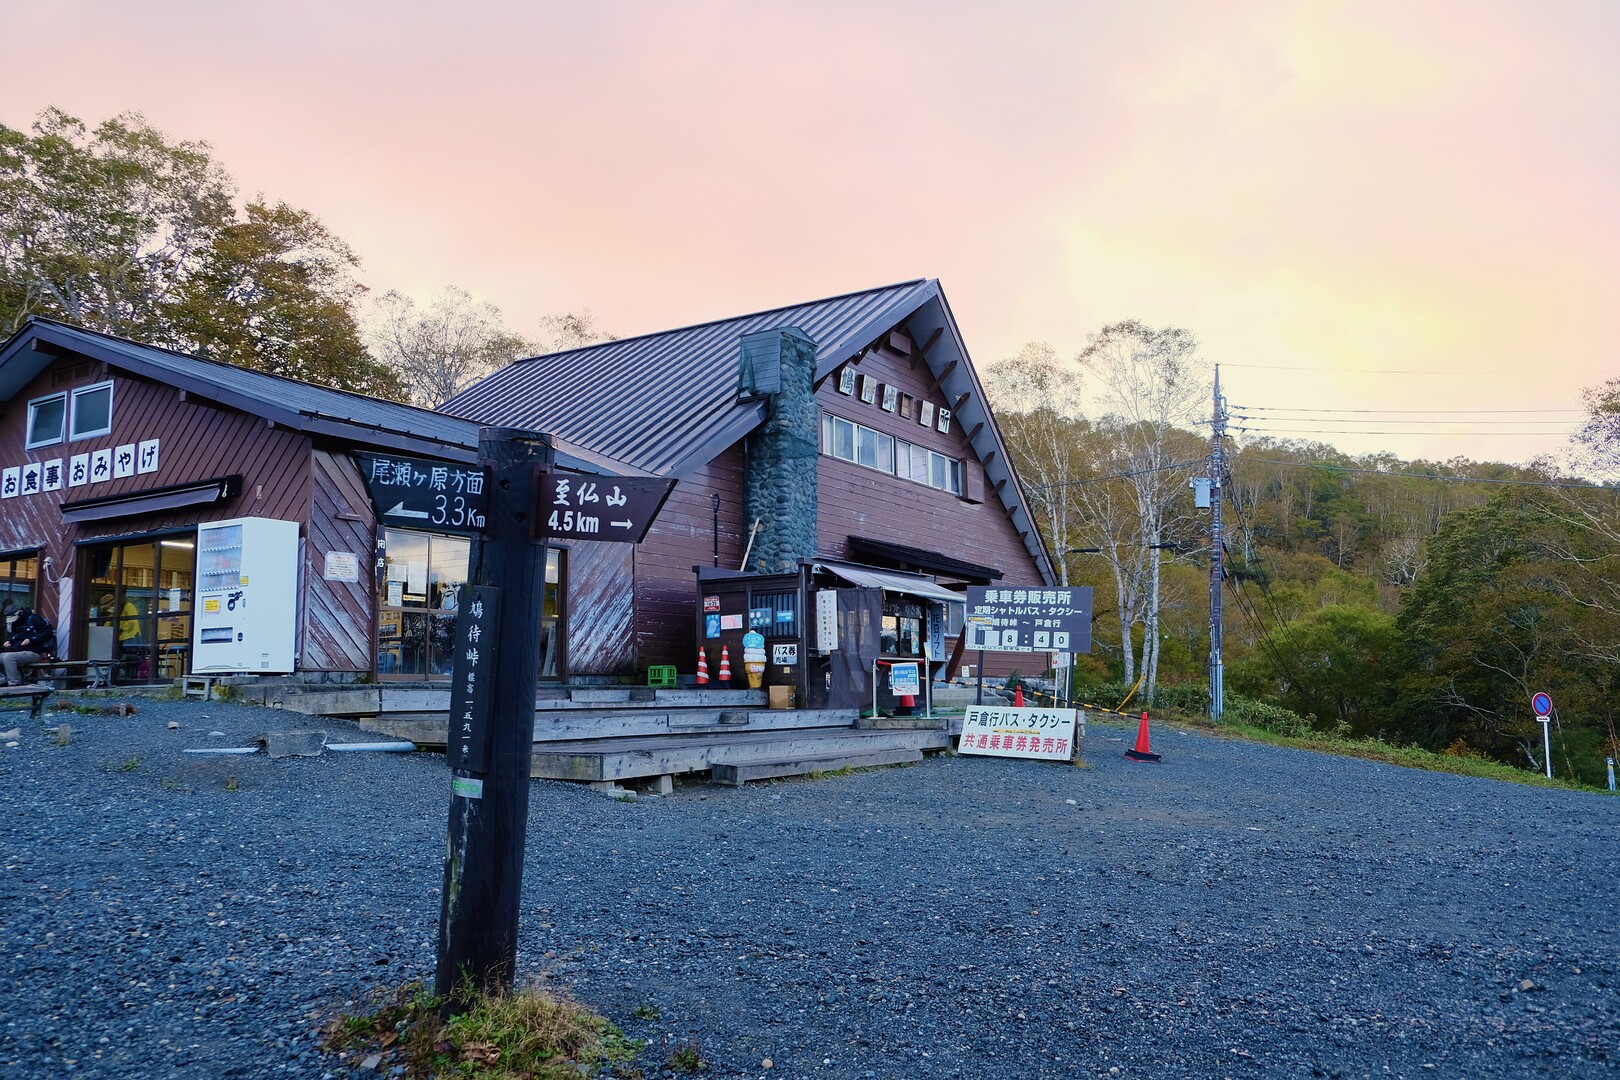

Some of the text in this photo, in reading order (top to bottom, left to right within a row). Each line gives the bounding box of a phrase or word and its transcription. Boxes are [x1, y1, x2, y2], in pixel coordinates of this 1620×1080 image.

[4, 445, 157, 494] お食事 おみやげ
[552, 479, 627, 507] 至仏山
[984, 589, 1072, 605] 乗車券販売所
[974, 605, 1083, 616] 定期シャトルバス・タクシー
[1034, 618, 1061, 628] 戸倉行
[466, 600, 484, 668] 鳩待峠
[774, 645, 796, 656] バス券
[967, 711, 1071, 729] 戸倉行バス・タクシー
[963, 732, 1069, 755] 共通乗車券発売所
